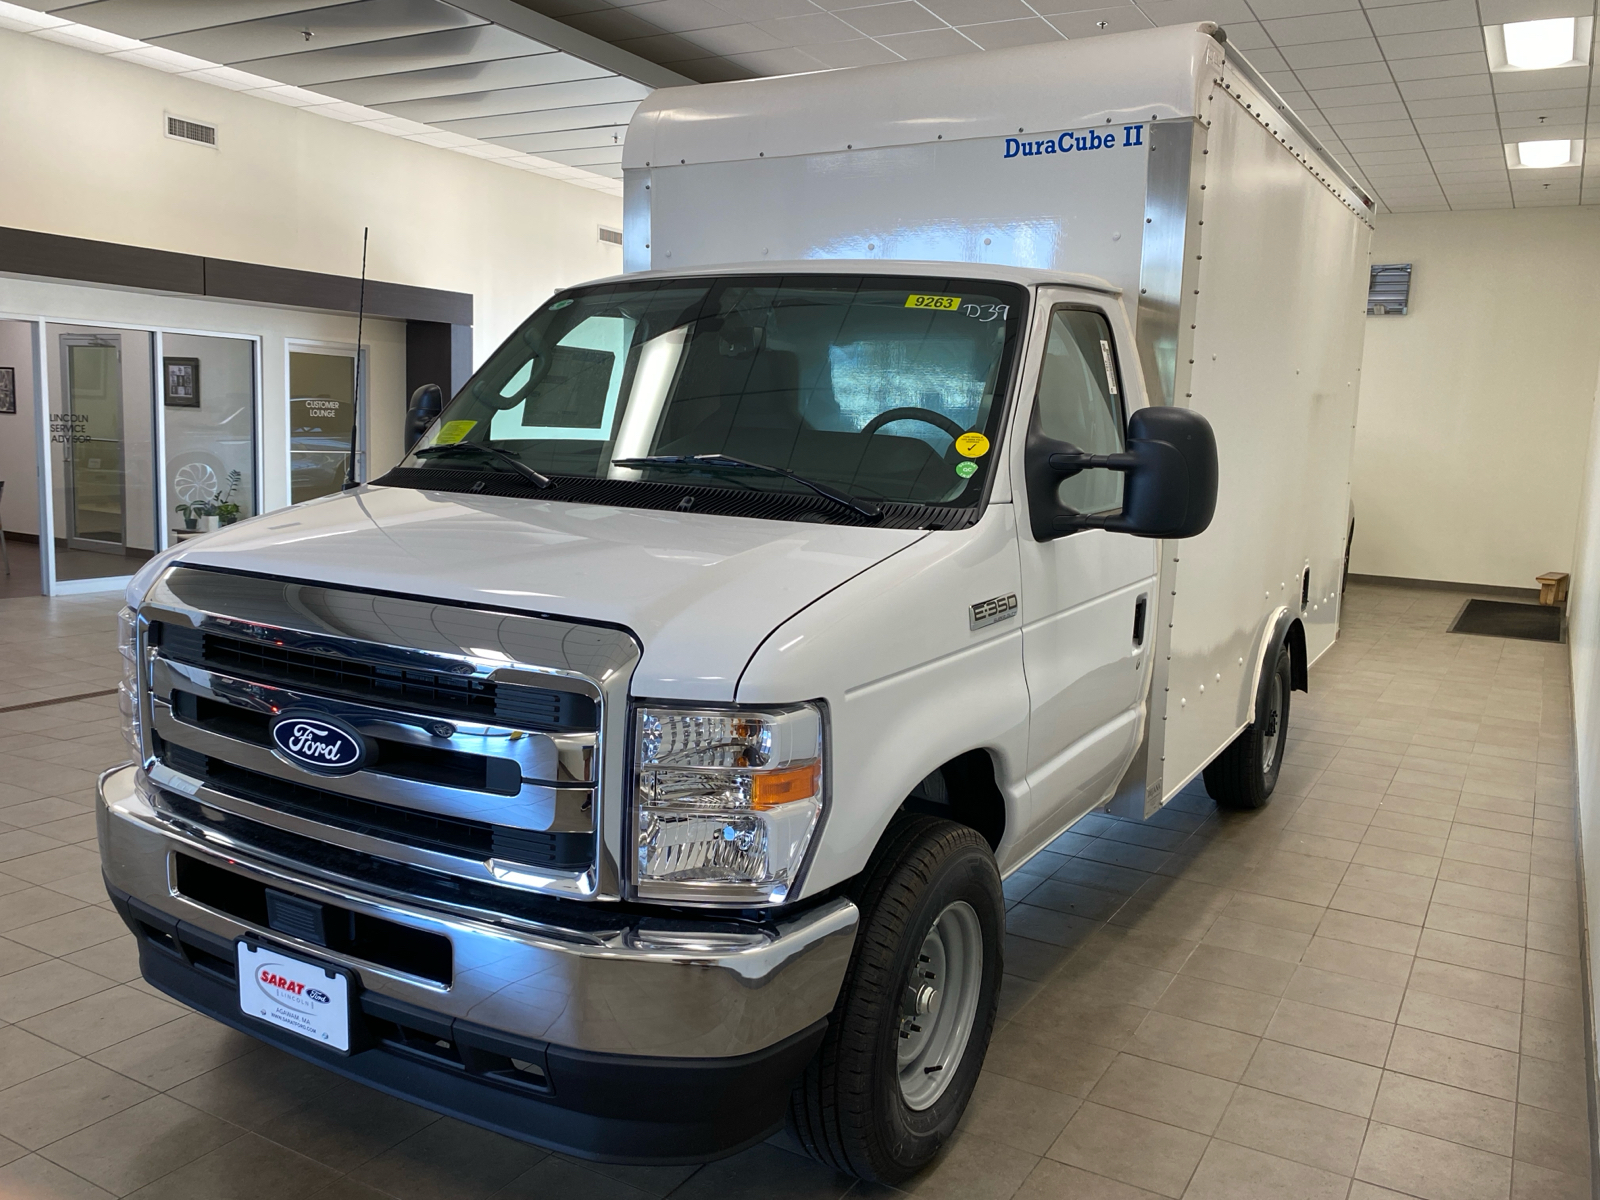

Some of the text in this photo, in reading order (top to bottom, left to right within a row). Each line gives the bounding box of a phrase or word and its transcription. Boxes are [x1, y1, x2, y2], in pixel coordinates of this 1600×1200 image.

[1003, 124, 1144, 159] DuraCube II
[914, 296, 954, 309] 9263
[963, 303, 1010, 322] D39
[305, 400, 340, 409] CUSTOMER
[49, 413, 89, 423] LINCOLN
[309, 409, 336, 418] LOUNGE
[50, 424, 86, 433] SERVICE
[51, 434, 92, 444] ADVISOR
[288, 724, 342, 761] Ford
[260, 969, 306, 996] SARAT
[280, 991, 310, 1007] LINCOLN
[309, 989, 327, 1002] Ford
[301, 1016, 311, 1025] MA
